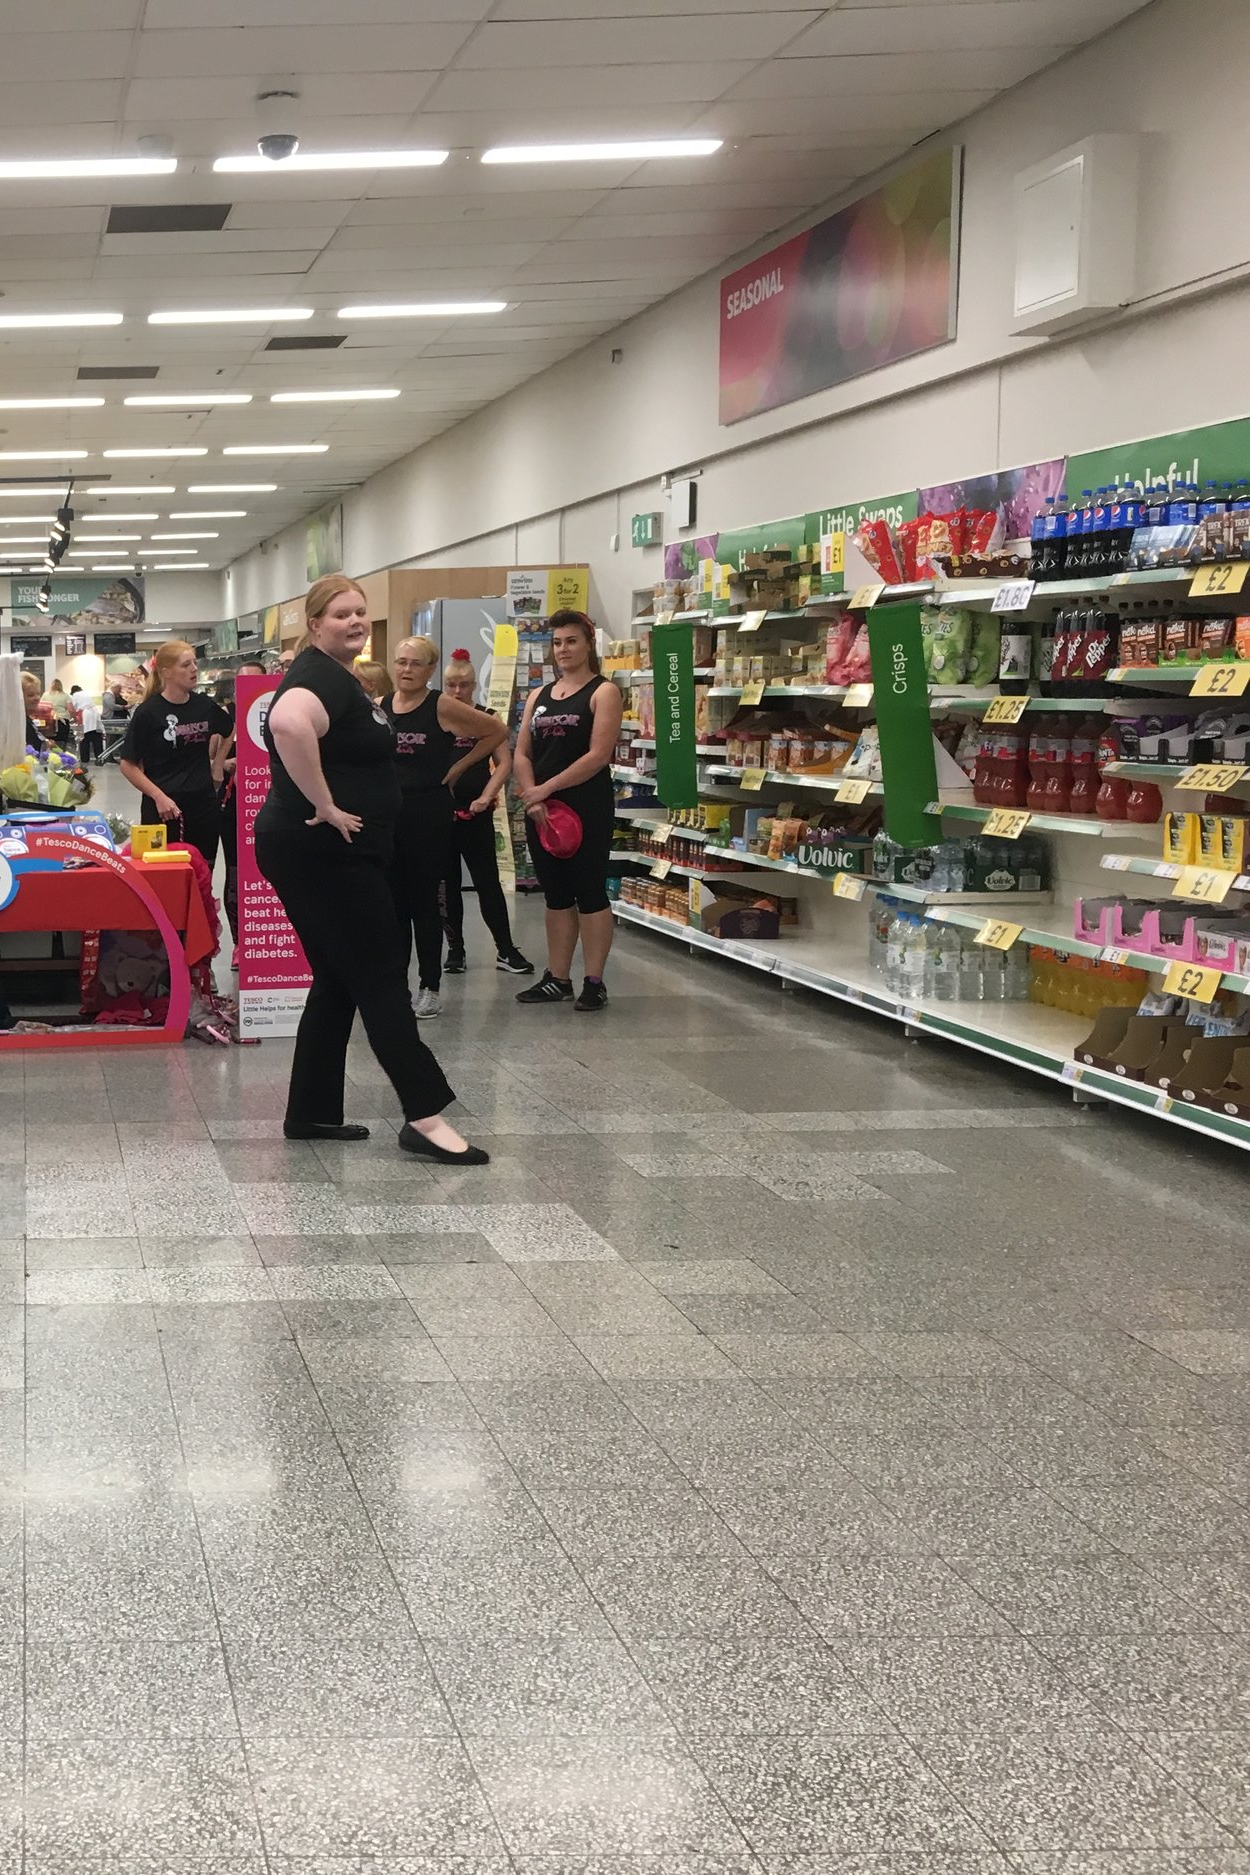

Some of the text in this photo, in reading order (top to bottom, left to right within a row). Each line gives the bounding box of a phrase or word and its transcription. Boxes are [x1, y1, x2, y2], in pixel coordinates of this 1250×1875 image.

[727, 267, 784, 320] SEASONAL
[820, 510, 854, 536] Little
[1206, 566, 1233, 591] £2
[18, 593, 80, 603] FISHONGER
[557, 584, 563, 594] 3
[572, 583, 579, 594] 2
[1085, 634, 1111, 669] Pepper
[892, 643, 908, 694] Crisps
[1207, 669, 1236, 693] £2
[667, 652, 681, 743] Tea and Cereal
[987, 700, 1025, 719] £1.25
[244, 765, 271, 776] Look
[1182, 768, 1238, 788] £1.50
[245, 779, 261, 790] for
[244, 793, 266, 804] dan
[35, 837, 126, 874] #TescoDanceBeats
[798, 846, 853, 869] Volvic
[244, 880, 273, 891] Let's
[1190, 872, 1218, 897] £1
[244, 895, 282, 905] cance
[244, 908, 270, 918] beat
[244, 921, 293, 932] diseases
[986, 925, 1008, 944] £1
[244, 934, 296, 947] and fight
[244, 949, 298, 959] diabetes.
[247, 974, 314, 983] #TescoDanceBe
[1177, 969, 1204, 996] £2
